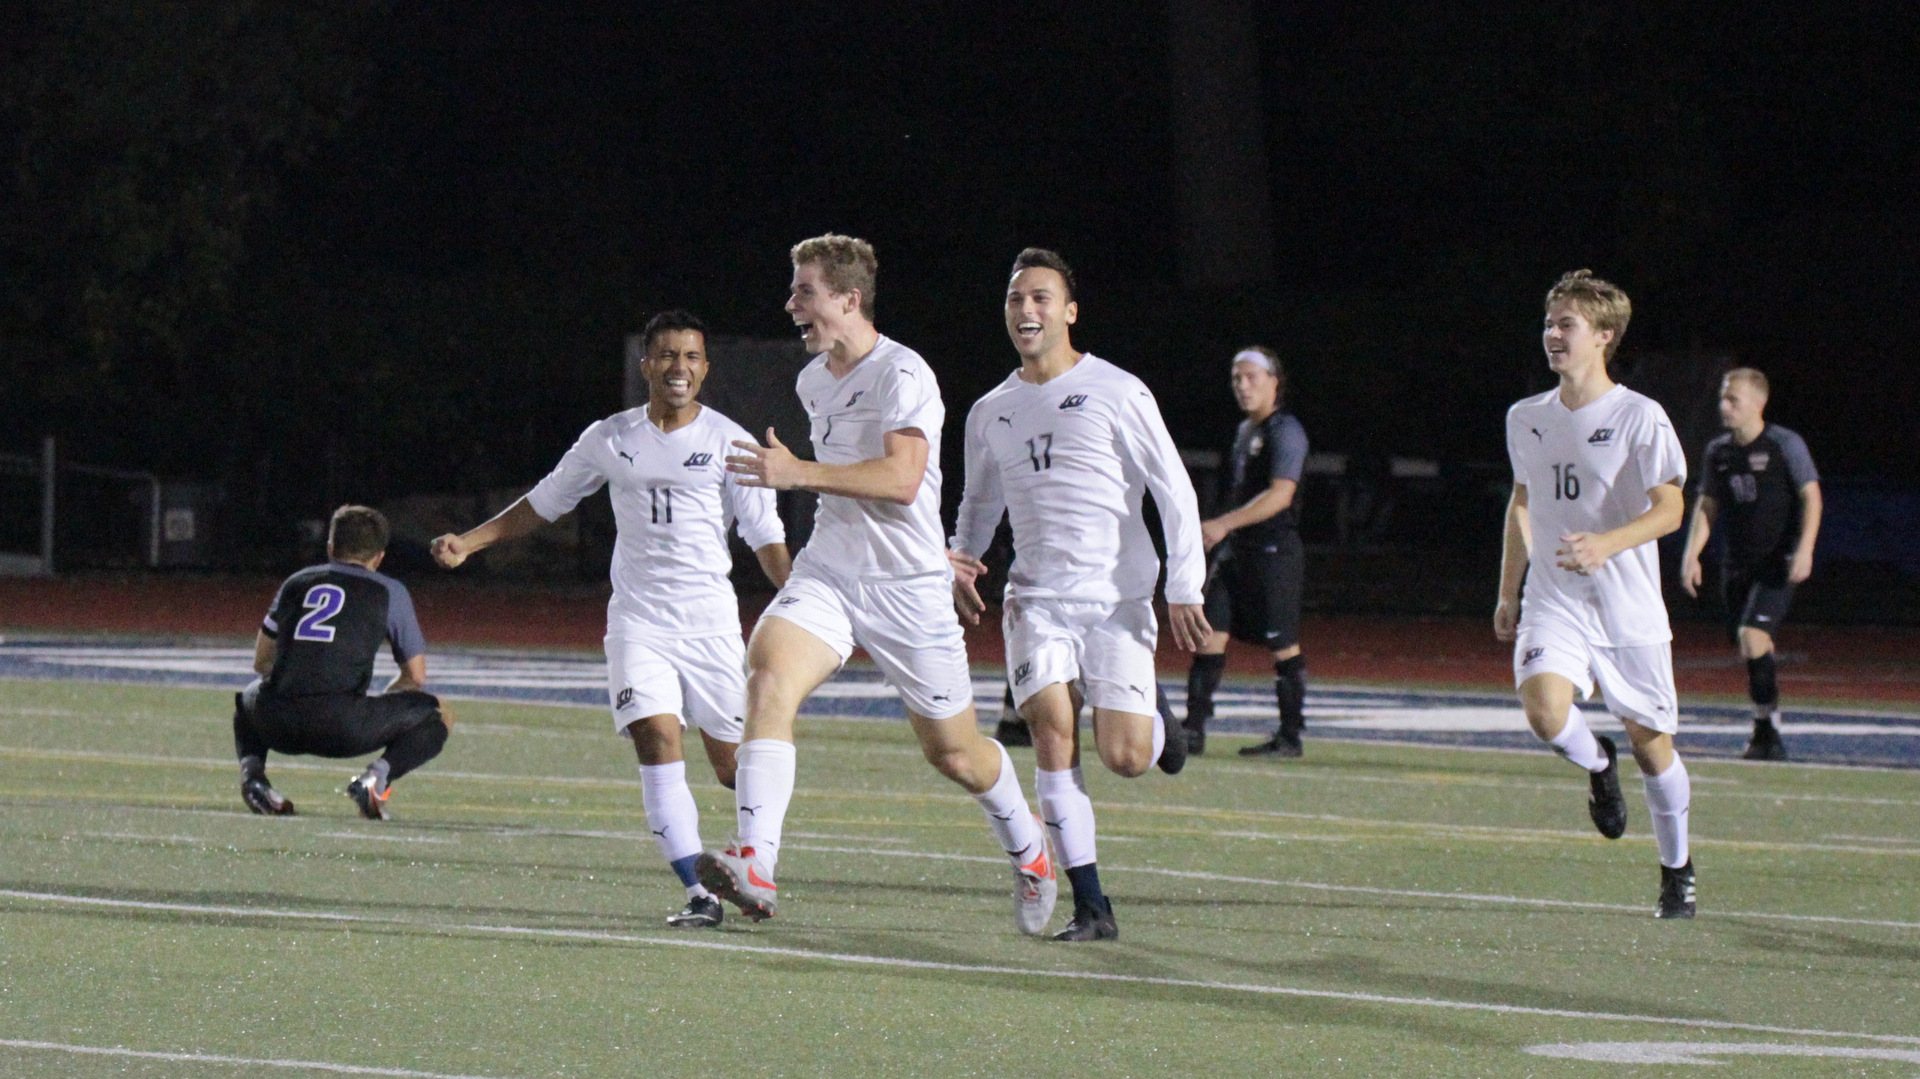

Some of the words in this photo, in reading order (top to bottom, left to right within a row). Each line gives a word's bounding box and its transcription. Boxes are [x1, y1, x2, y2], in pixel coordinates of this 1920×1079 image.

[683, 452, 713, 467] JCU
[1025, 432, 1053, 472] 17
[1552, 463, 1579, 500] 16
[649, 487, 672, 524] 11
[294, 583, 346, 642] 2
[616, 687, 633, 710] JCU
